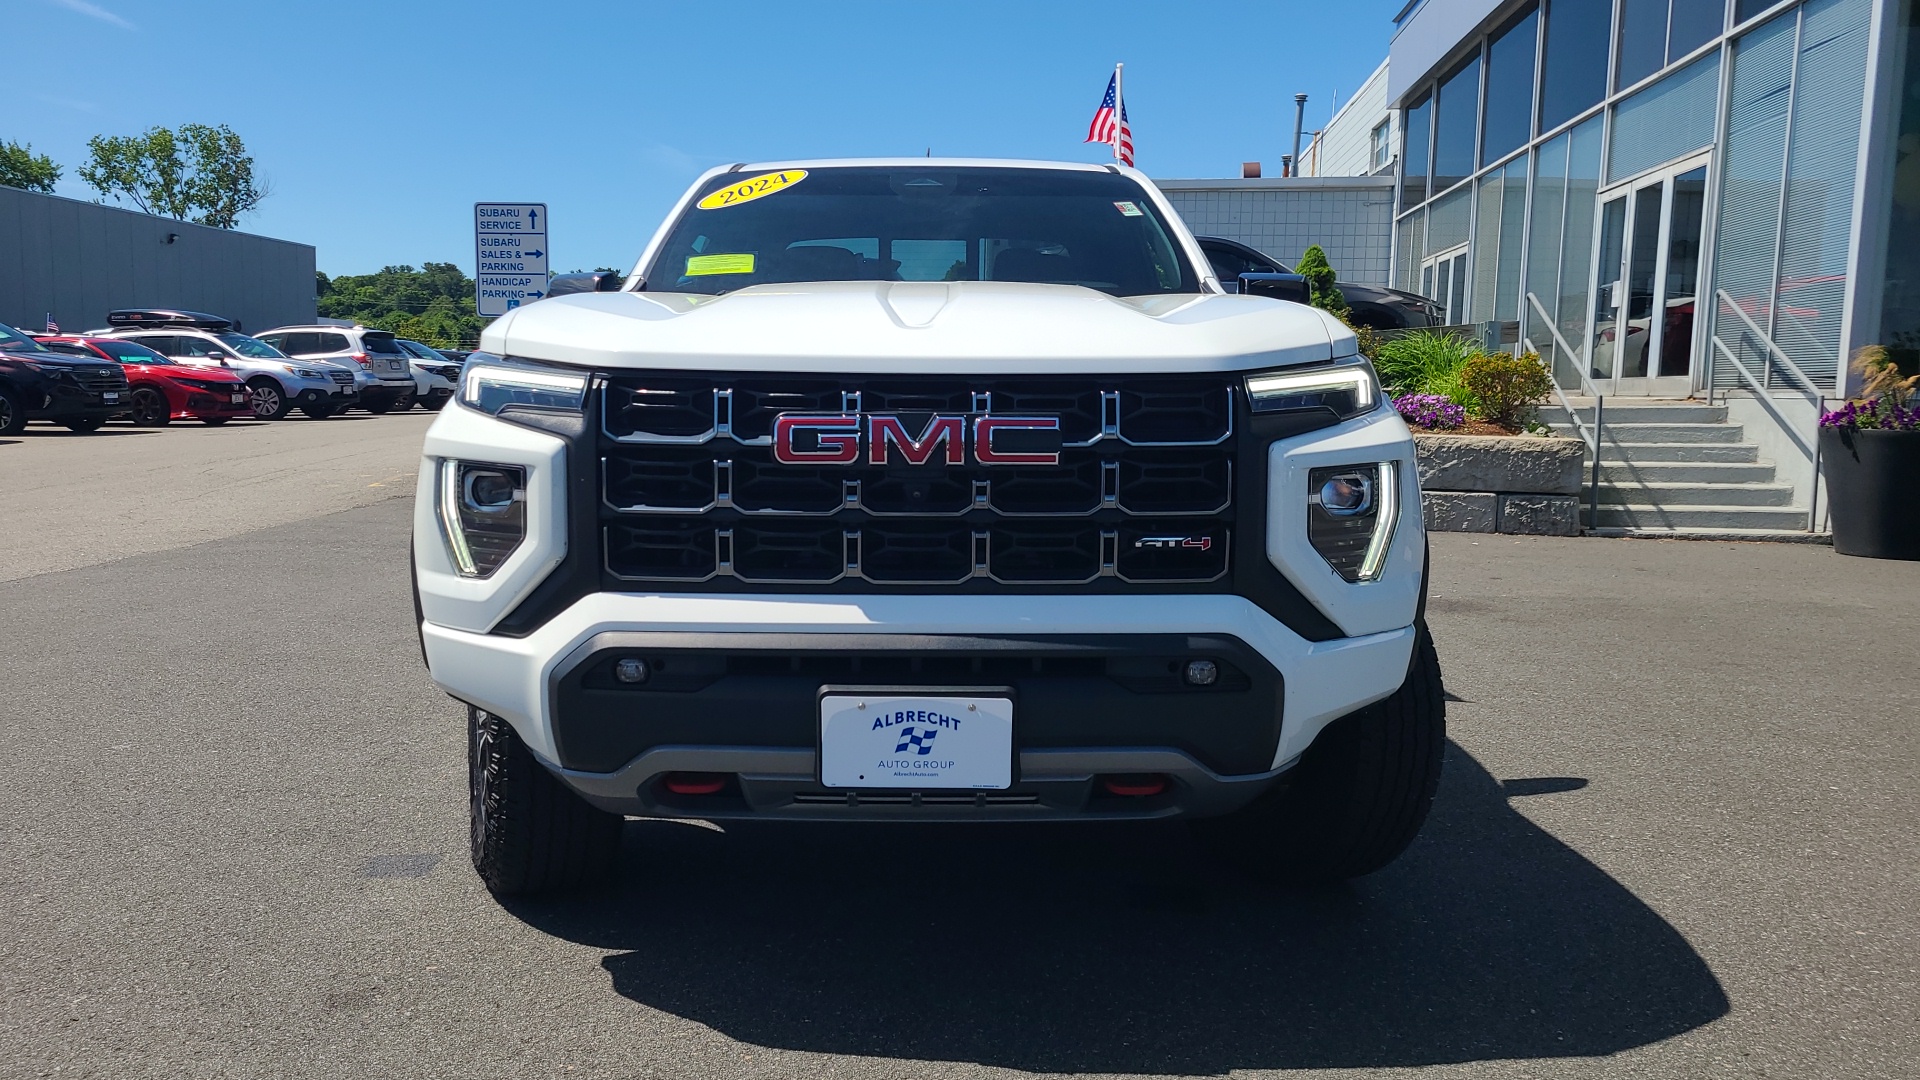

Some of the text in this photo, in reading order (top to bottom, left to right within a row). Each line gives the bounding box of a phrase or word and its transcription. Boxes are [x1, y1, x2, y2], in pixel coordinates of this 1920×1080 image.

[720, 173, 790, 204] 2024
[480, 209, 520, 217] SUBARU
[480, 221, 521, 230] SERVICE
[480, 238, 521, 247] SUBARU
[481, 250, 522, 259] SALES &
[481, 263, 524, 271] PARKING
[482, 278, 531, 286] HANDICAP
[482, 290, 525, 298] PARKING
[774, 414, 1060, 465] GMC
[1135, 537, 1211, 551] AT4
[872, 710, 961, 731] ALBRECHT
[878, 760, 955, 769] AUTO GROUP
